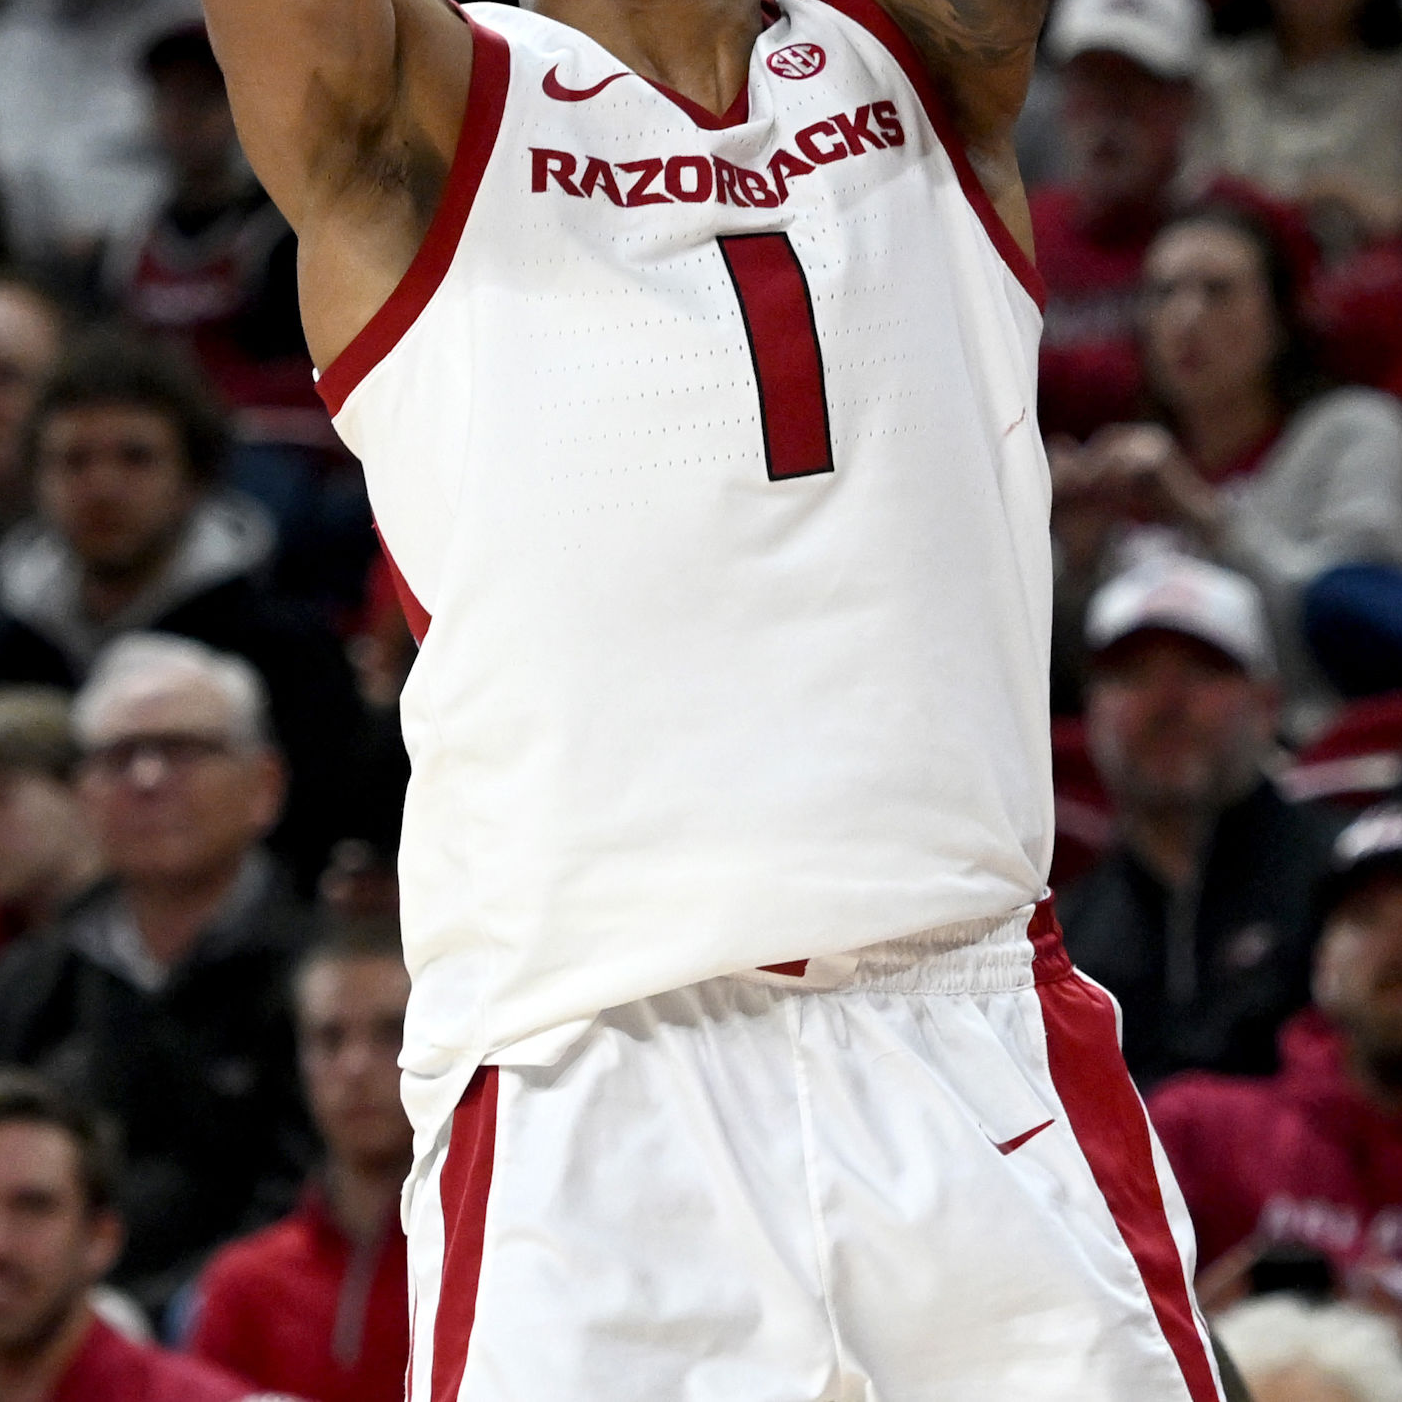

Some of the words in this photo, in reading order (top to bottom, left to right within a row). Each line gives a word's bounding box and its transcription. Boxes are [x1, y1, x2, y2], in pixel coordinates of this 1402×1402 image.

[769, 44, 822, 78] SEC
[528, 100, 906, 209] RAZORBACKS
[715, 231, 835, 482] 1
